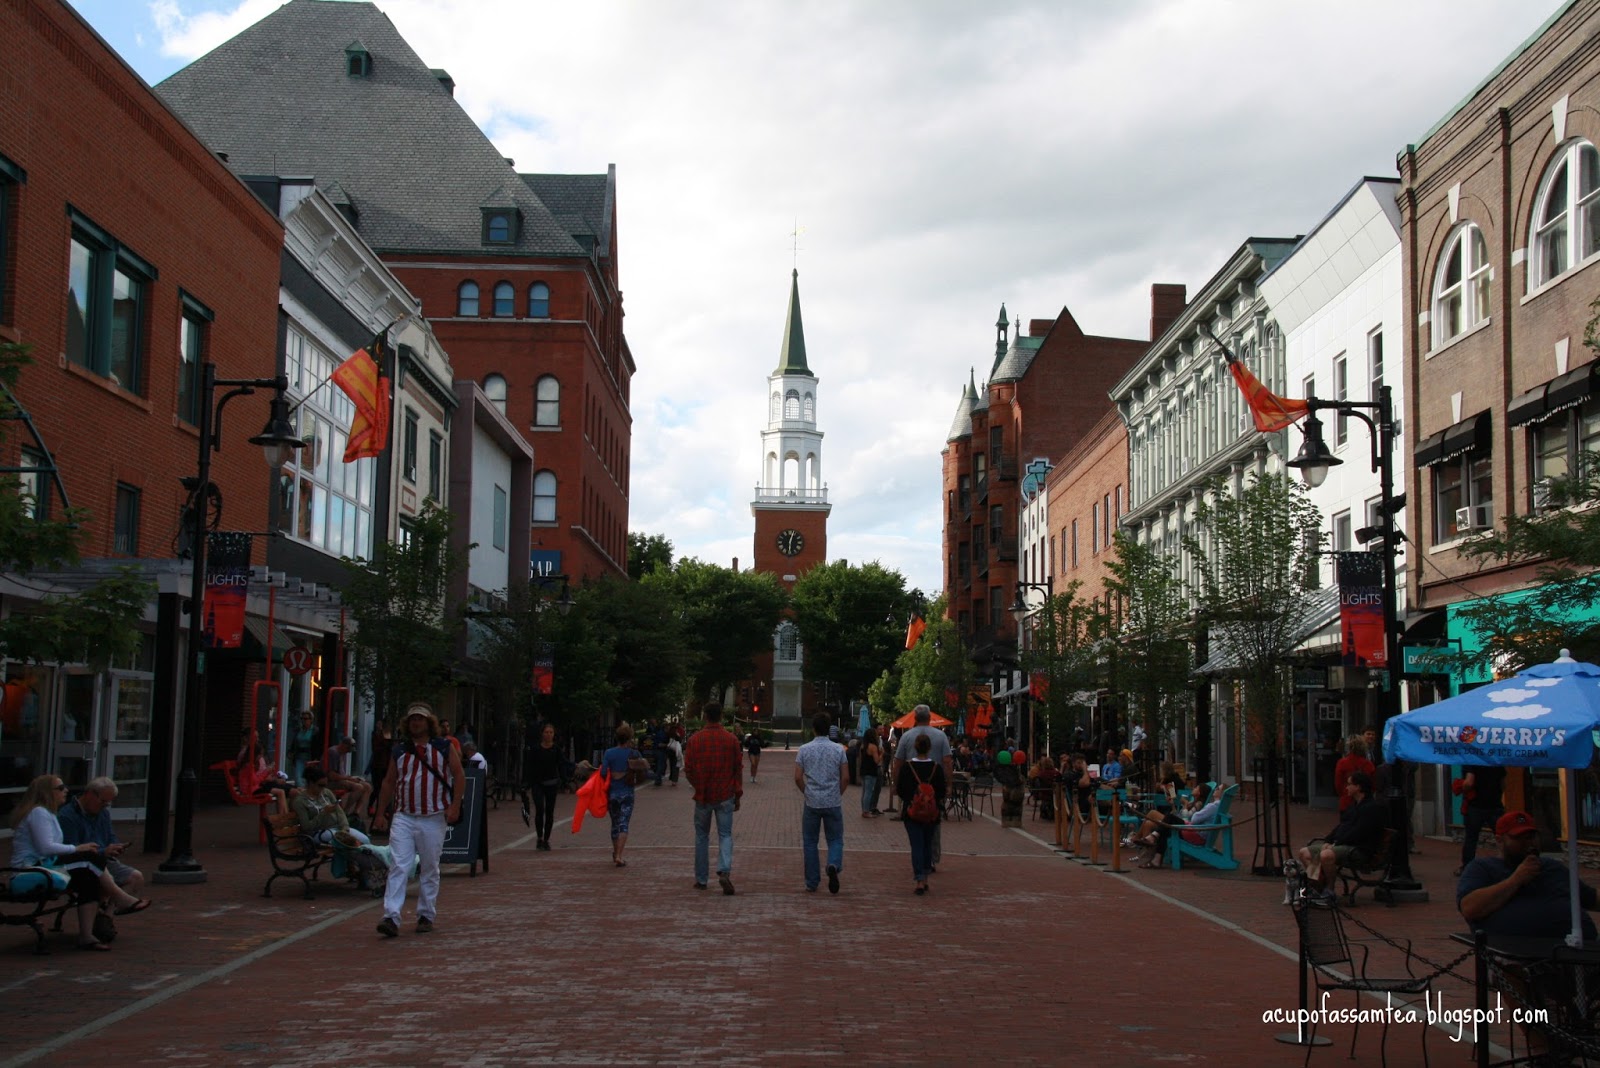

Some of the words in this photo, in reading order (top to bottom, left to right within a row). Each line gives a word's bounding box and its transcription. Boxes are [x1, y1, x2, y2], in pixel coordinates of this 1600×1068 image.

[207, 574, 247, 587] LIGHTS
[1341, 593, 1382, 605] LIGHTS
[1498, 748, 1512, 757] ICE
[1514, 749, 1549, 759] CREAM
